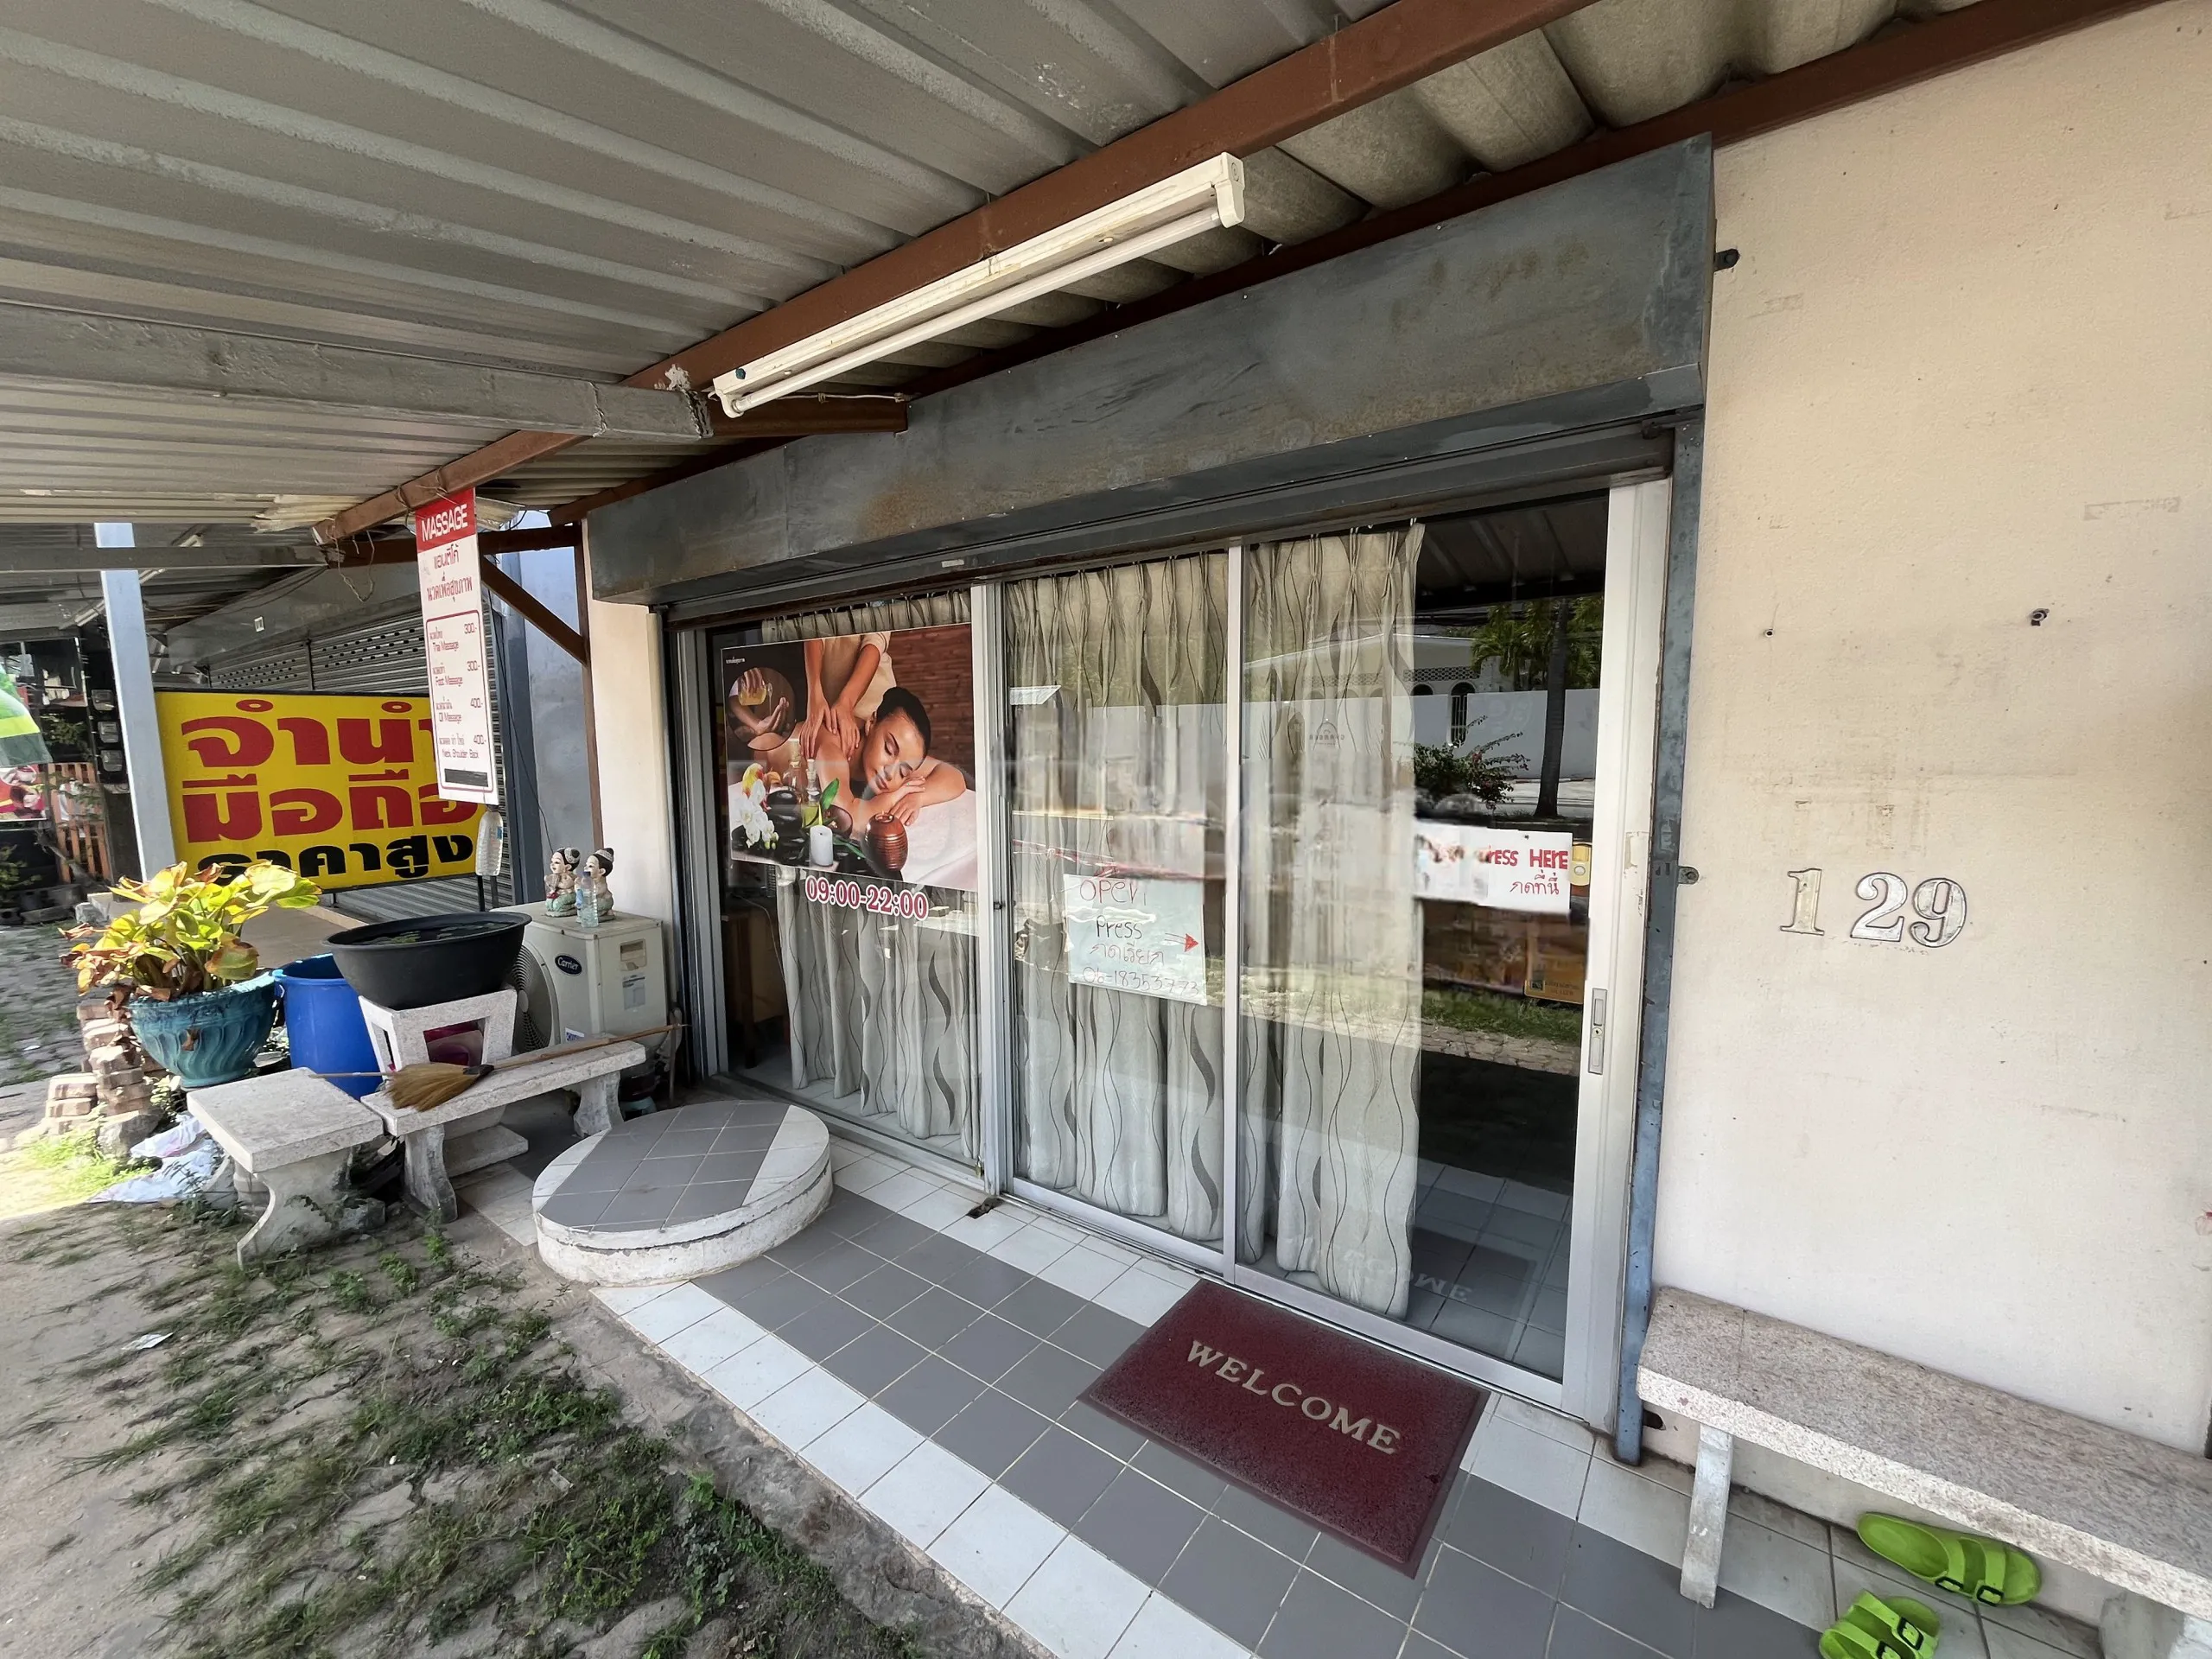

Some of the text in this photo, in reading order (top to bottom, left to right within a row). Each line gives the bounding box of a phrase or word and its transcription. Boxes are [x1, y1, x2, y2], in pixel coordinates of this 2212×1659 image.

[421, 504, 468, 542] MASSAGE
[805, 875, 929, 921] 09:00-22:00
[1510, 869, 1560, 896] กดที่นี่
[1096, 914, 1143, 940] Press
[557, 957, 579, 971] Carrier
[1186, 1340, 1401, 1455] WELCOME
